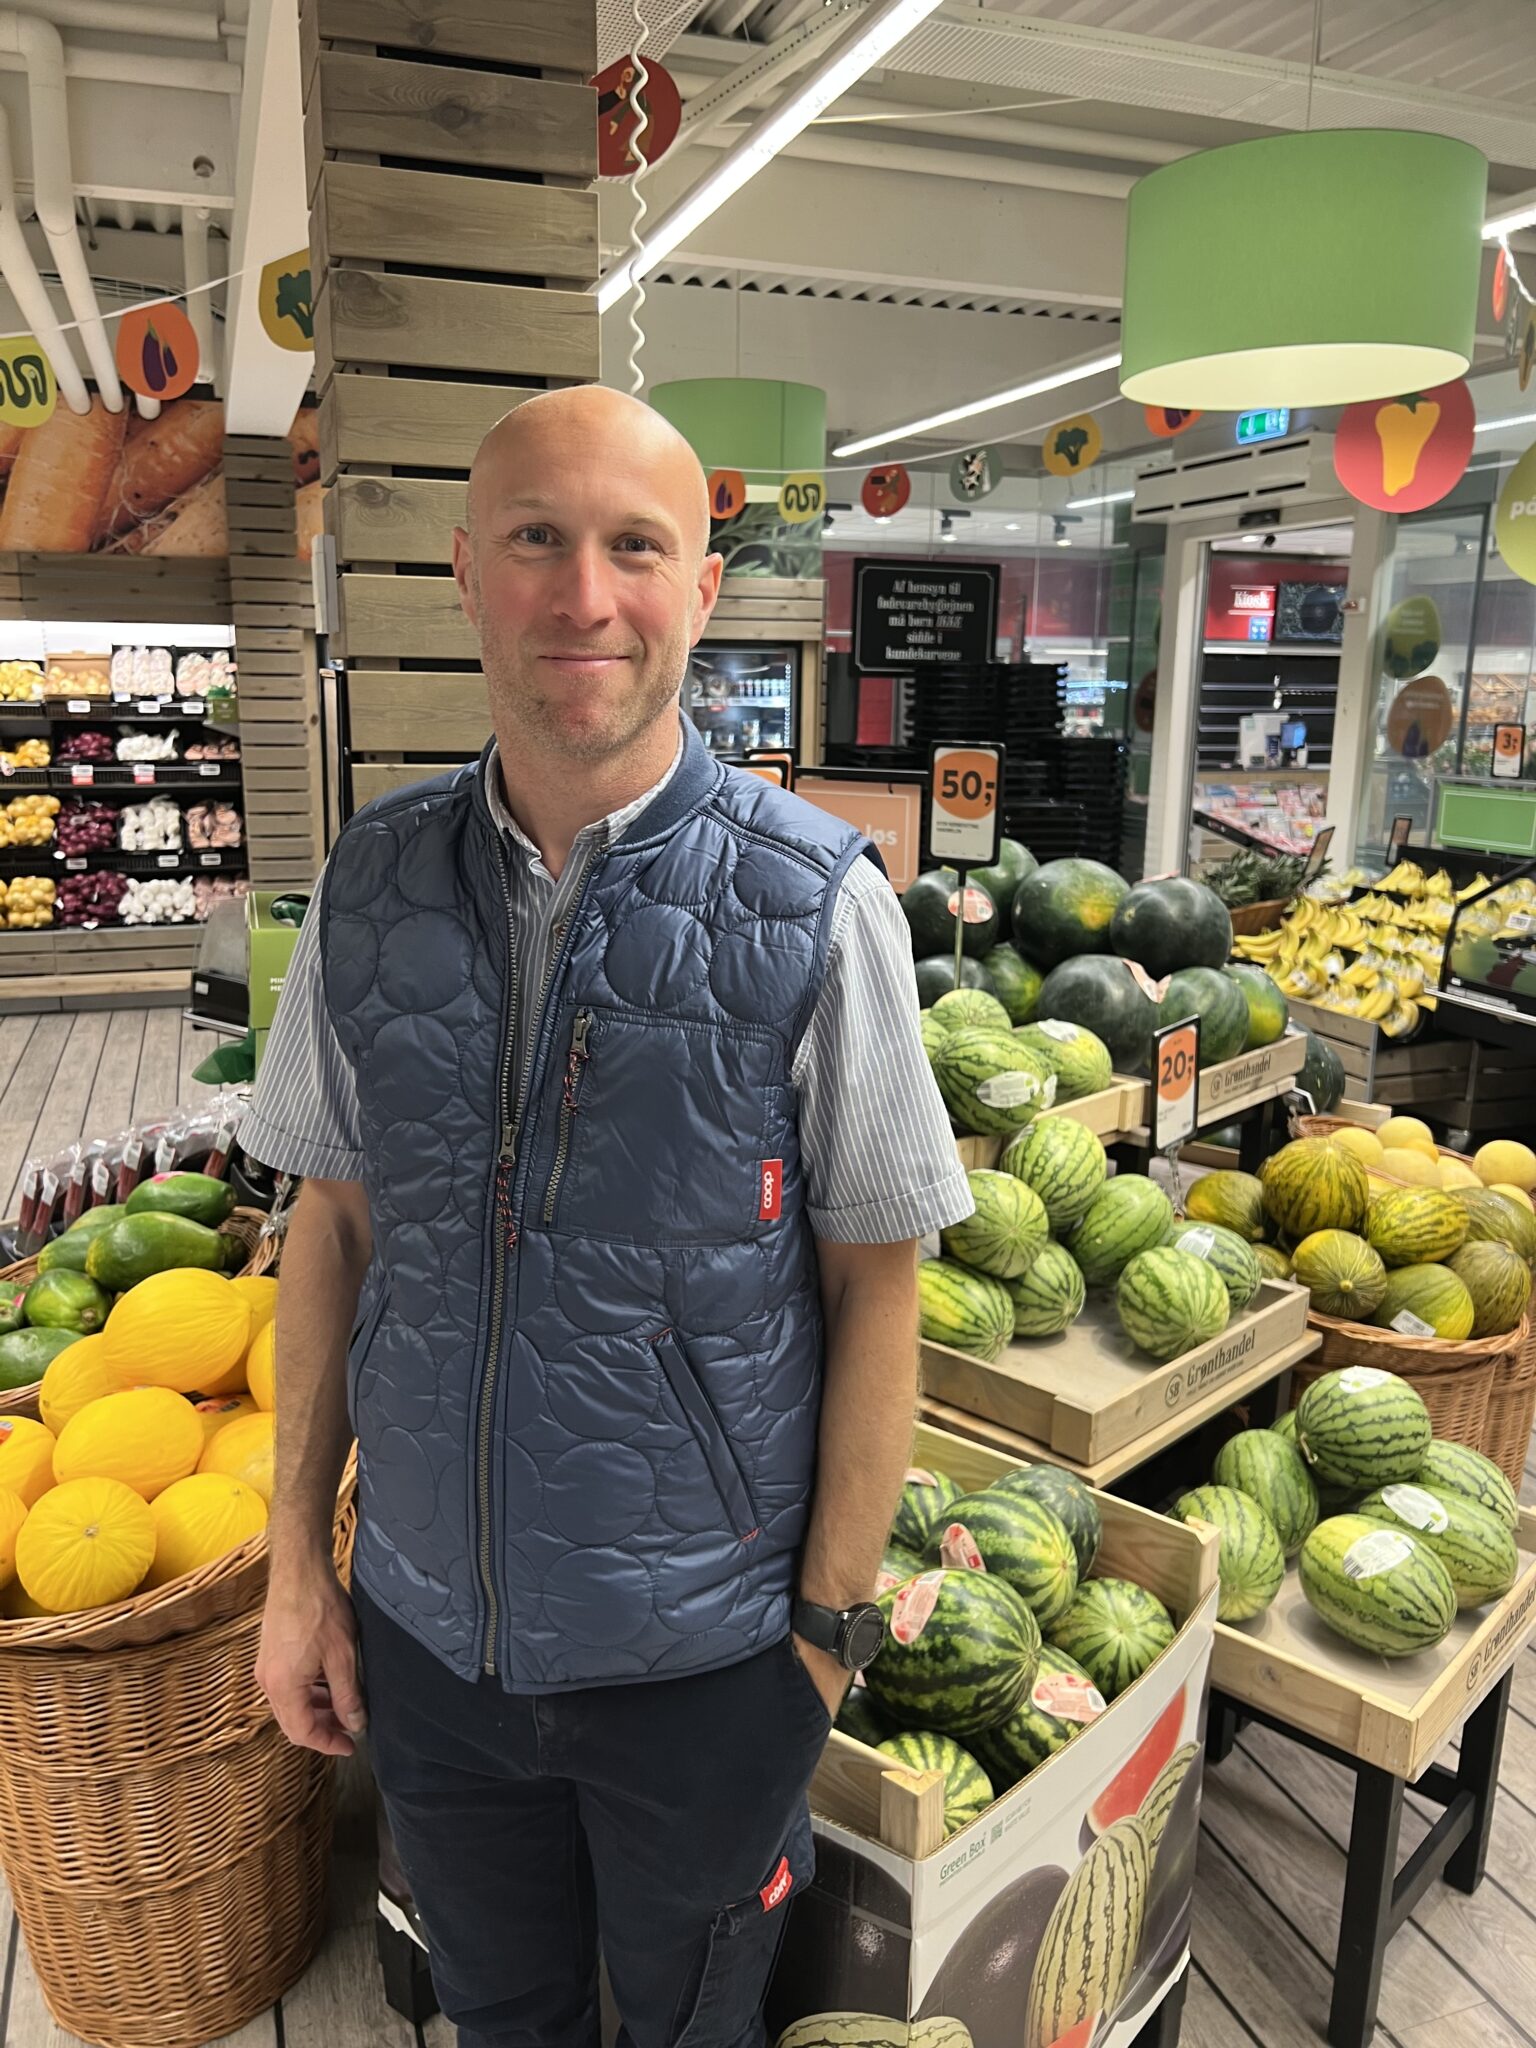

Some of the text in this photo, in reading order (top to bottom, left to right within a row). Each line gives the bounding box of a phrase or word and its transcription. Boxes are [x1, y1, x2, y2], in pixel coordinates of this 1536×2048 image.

[893, 580, 961, 597] Af hensyn til
[1233, 590, 1270, 609] Kiosk
[907, 614, 933, 628] børn
[906, 632, 943, 644] sidde i
[763, 1170, 775, 1209] coop
[1187, 1328, 1255, 1387] Grønthandel
[1168, 1381, 1180, 1400] SB
[940, 1851, 967, 1879] Green
[968, 1839, 985, 1858] Box
